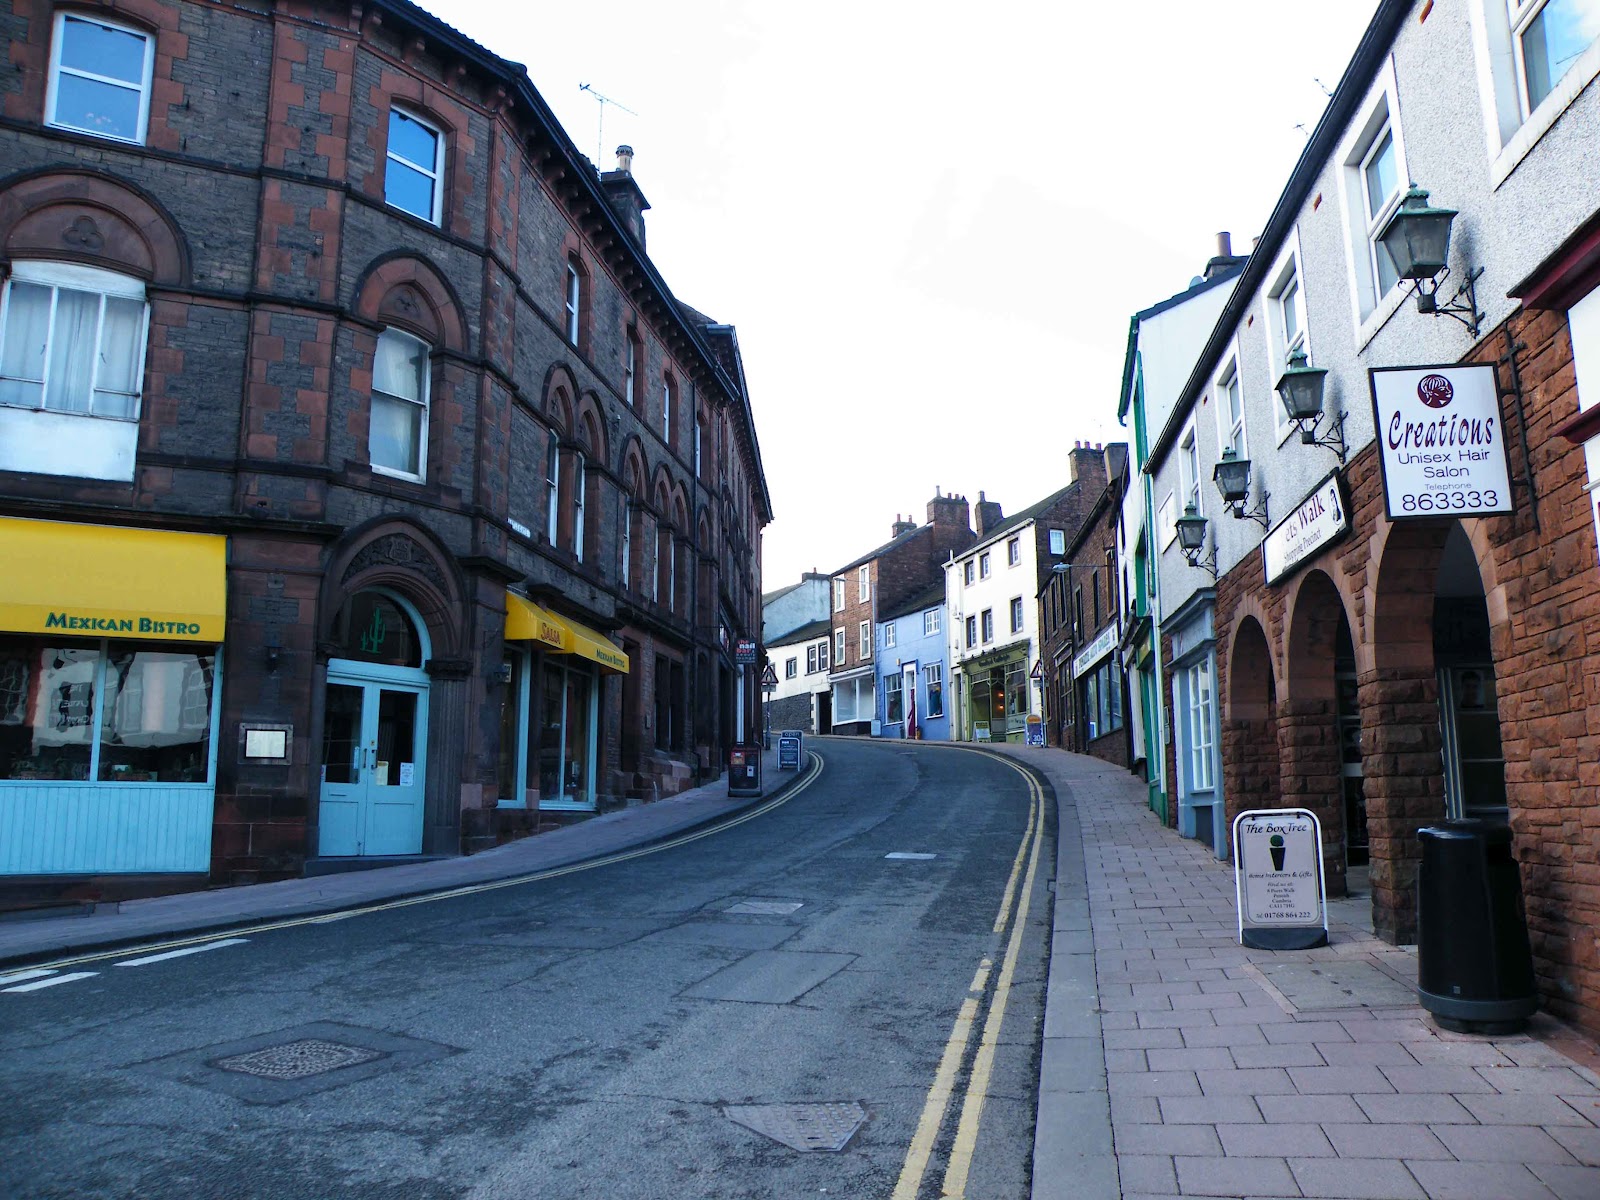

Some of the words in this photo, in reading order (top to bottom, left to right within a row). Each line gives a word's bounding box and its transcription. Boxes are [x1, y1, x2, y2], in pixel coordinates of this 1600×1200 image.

[1388, 410, 1494, 450] Creations
[1397, 452, 1452, 465] Unisex
[1458, 450, 1490, 461] Hair
[1423, 466, 1470, 479] Salon
[1424, 482, 1472, 491] Telephone
[1402, 490, 1499, 512] 863333
[1297, 494, 1326, 530] Walk
[45, 612, 133, 632] MEXICAN
[138, 617, 200, 635] BISTRO
[1246, 823, 1264, 834] The
[1266, 823, 1289, 835] Box
[1288, 822, 1307, 833] Tree
[1299, 871, 1312, 879] Gifts
